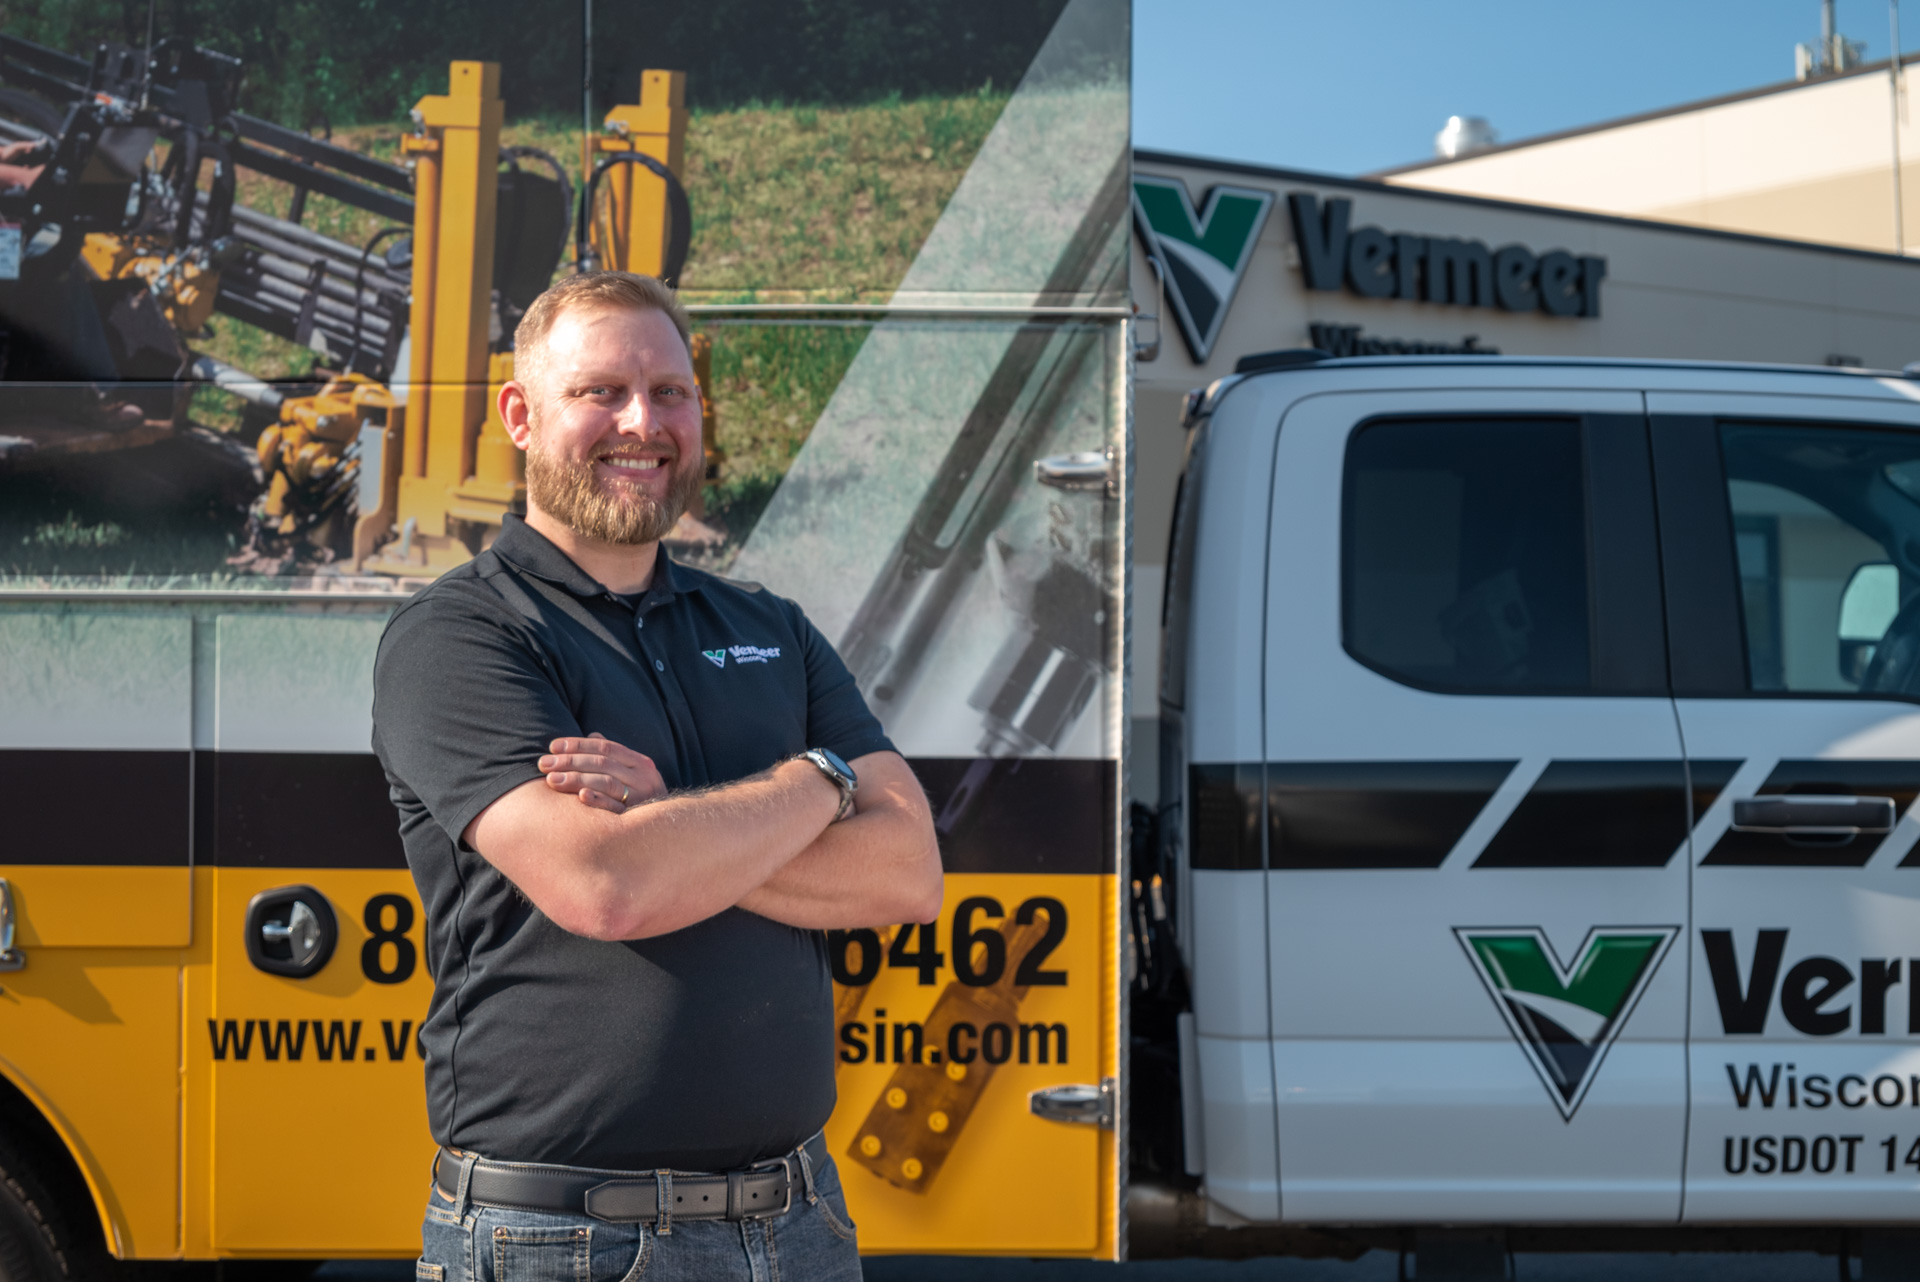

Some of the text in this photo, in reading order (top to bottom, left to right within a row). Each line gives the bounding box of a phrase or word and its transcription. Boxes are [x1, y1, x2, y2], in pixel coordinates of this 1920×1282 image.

[1289, 192, 1607, 318] Vermeer
[1700, 928, 1920, 1036] Ver
[1724, 1135, 1863, 1175] USDOT
